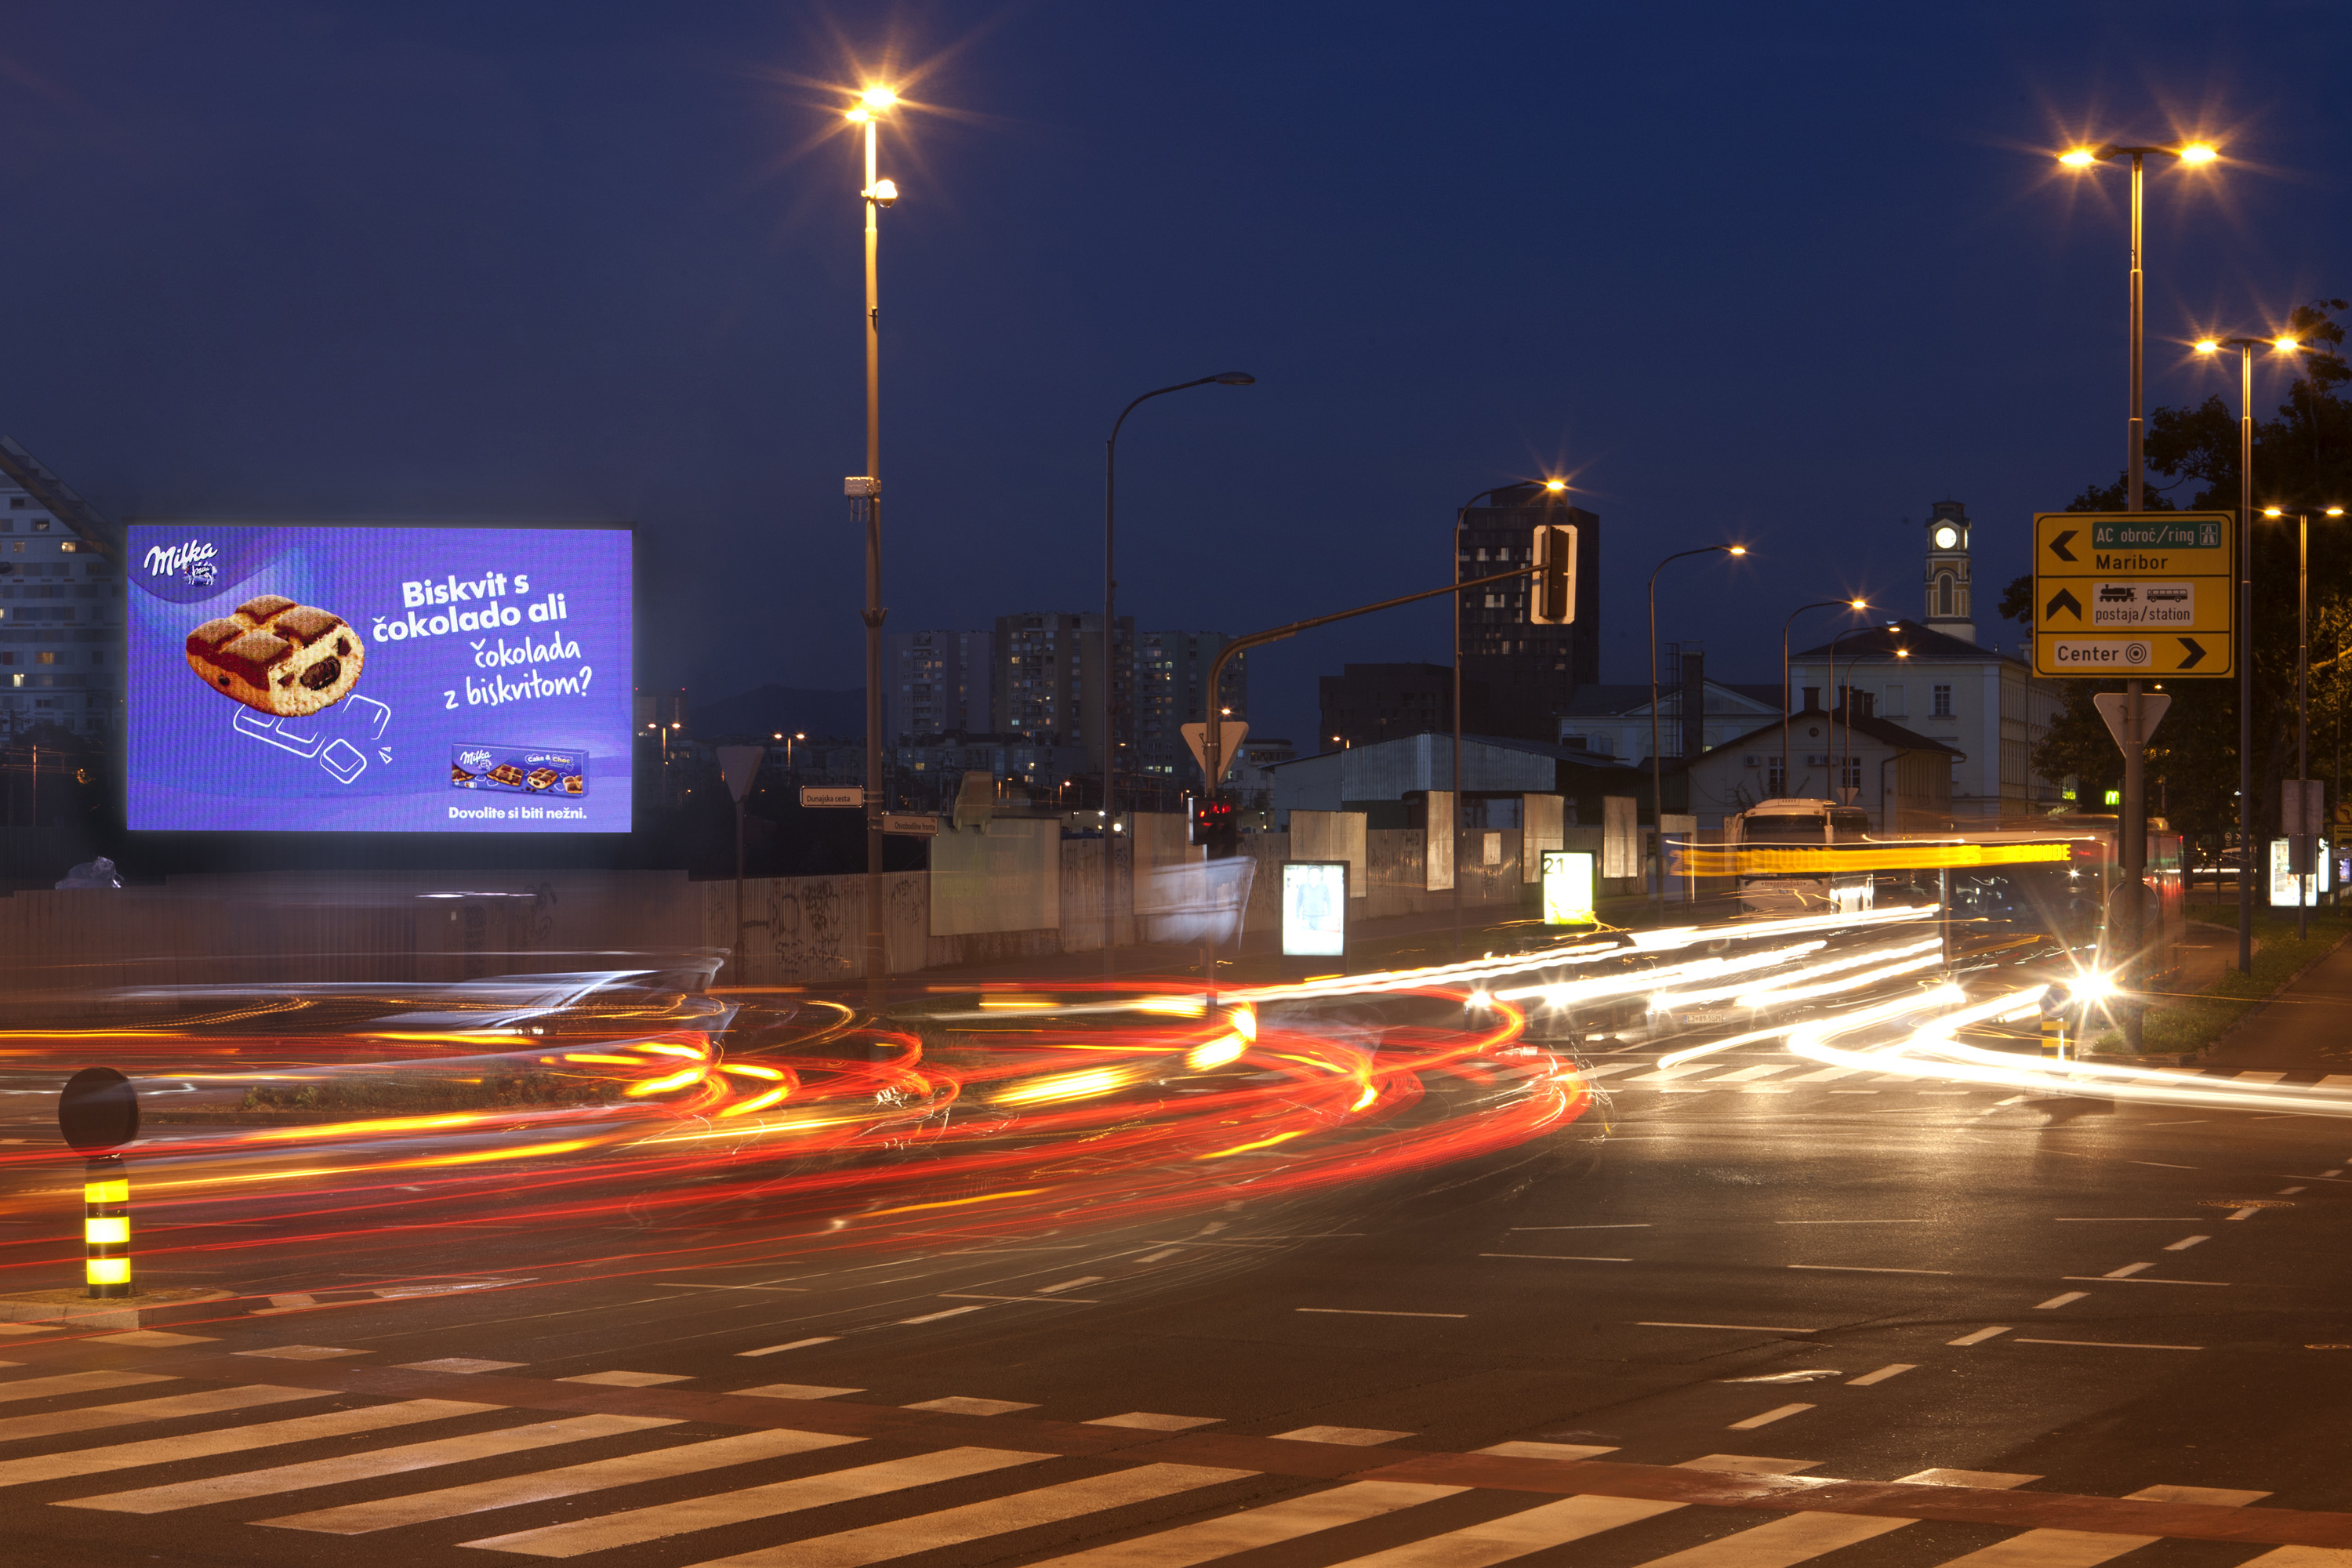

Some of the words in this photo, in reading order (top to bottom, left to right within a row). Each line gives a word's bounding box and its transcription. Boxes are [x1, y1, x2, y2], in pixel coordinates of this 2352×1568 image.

[2096, 528, 2114, 543] AC
[2121, 525, 2194, 545] obroč/ring
[143, 539, 218, 576] Milka
[2096, 554, 2169, 569] Maribor
[402, 571, 507, 608] Biskvit
[514, 574, 529, 593] s
[372, 601, 521, 642] čokolado
[528, 593, 567, 622] ali
[2096, 606, 2190, 623] postaja/station
[470, 630, 581, 668] čokolada
[2057, 645, 2119, 661] Center
[444, 690, 459, 710] z
[466, 666, 592, 706] biskvitom?
[459, 750, 492, 764] Milka
[807, 794, 833, 804] Dunajska
[448, 807, 505, 818] Dovolite
[508, 808, 518, 818] si
[521, 807, 543, 818] biti
[546, 808, 587, 819] nežni.
[895, 822, 921, 830] Osvobodilne
